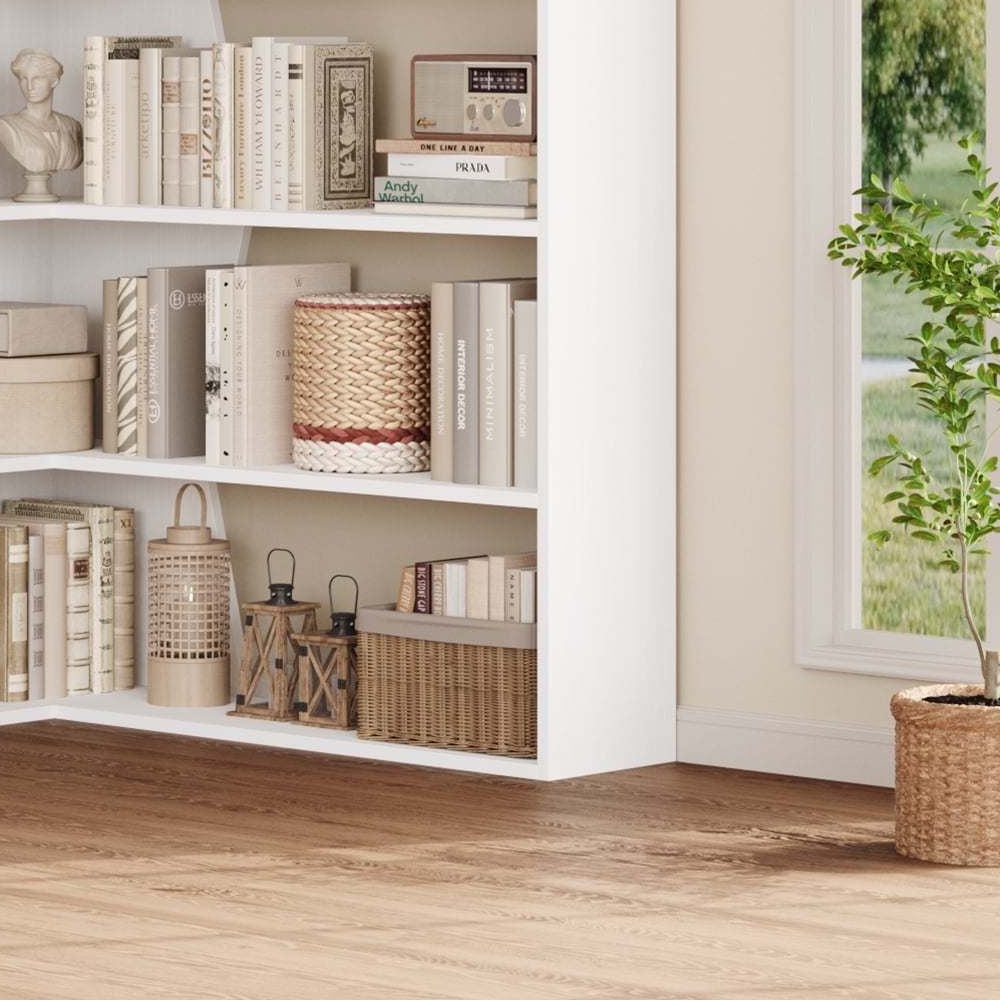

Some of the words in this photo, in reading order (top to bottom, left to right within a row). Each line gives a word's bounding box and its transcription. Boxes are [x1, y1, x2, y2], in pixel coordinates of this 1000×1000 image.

[237, 54, 245, 99] London
[254, 54, 265, 126] YEOWARD
[237, 99, 245, 158] Furniture
[274, 54, 282, 202] BERNHARDT
[420, 143, 437, 152] ONE
[439, 143, 460, 152] LINE
[460, 144, 469, 153] A
[468, 145, 485, 154] DAY
[237, 158, 245, 201] Luxury
[254, 127, 265, 192] WILLIAM
[455, 161, 491, 174] PRADA
[378, 192, 425, 204] Warhol
[383, 179, 419, 196] Andy
[456, 339, 466, 392] INTERIOR
[484, 327, 495, 442] MINIMALISM
[519, 354, 528, 401] INTERIOR
[456, 393, 466, 431] DECOR
[519, 403, 528, 438] DECOR
